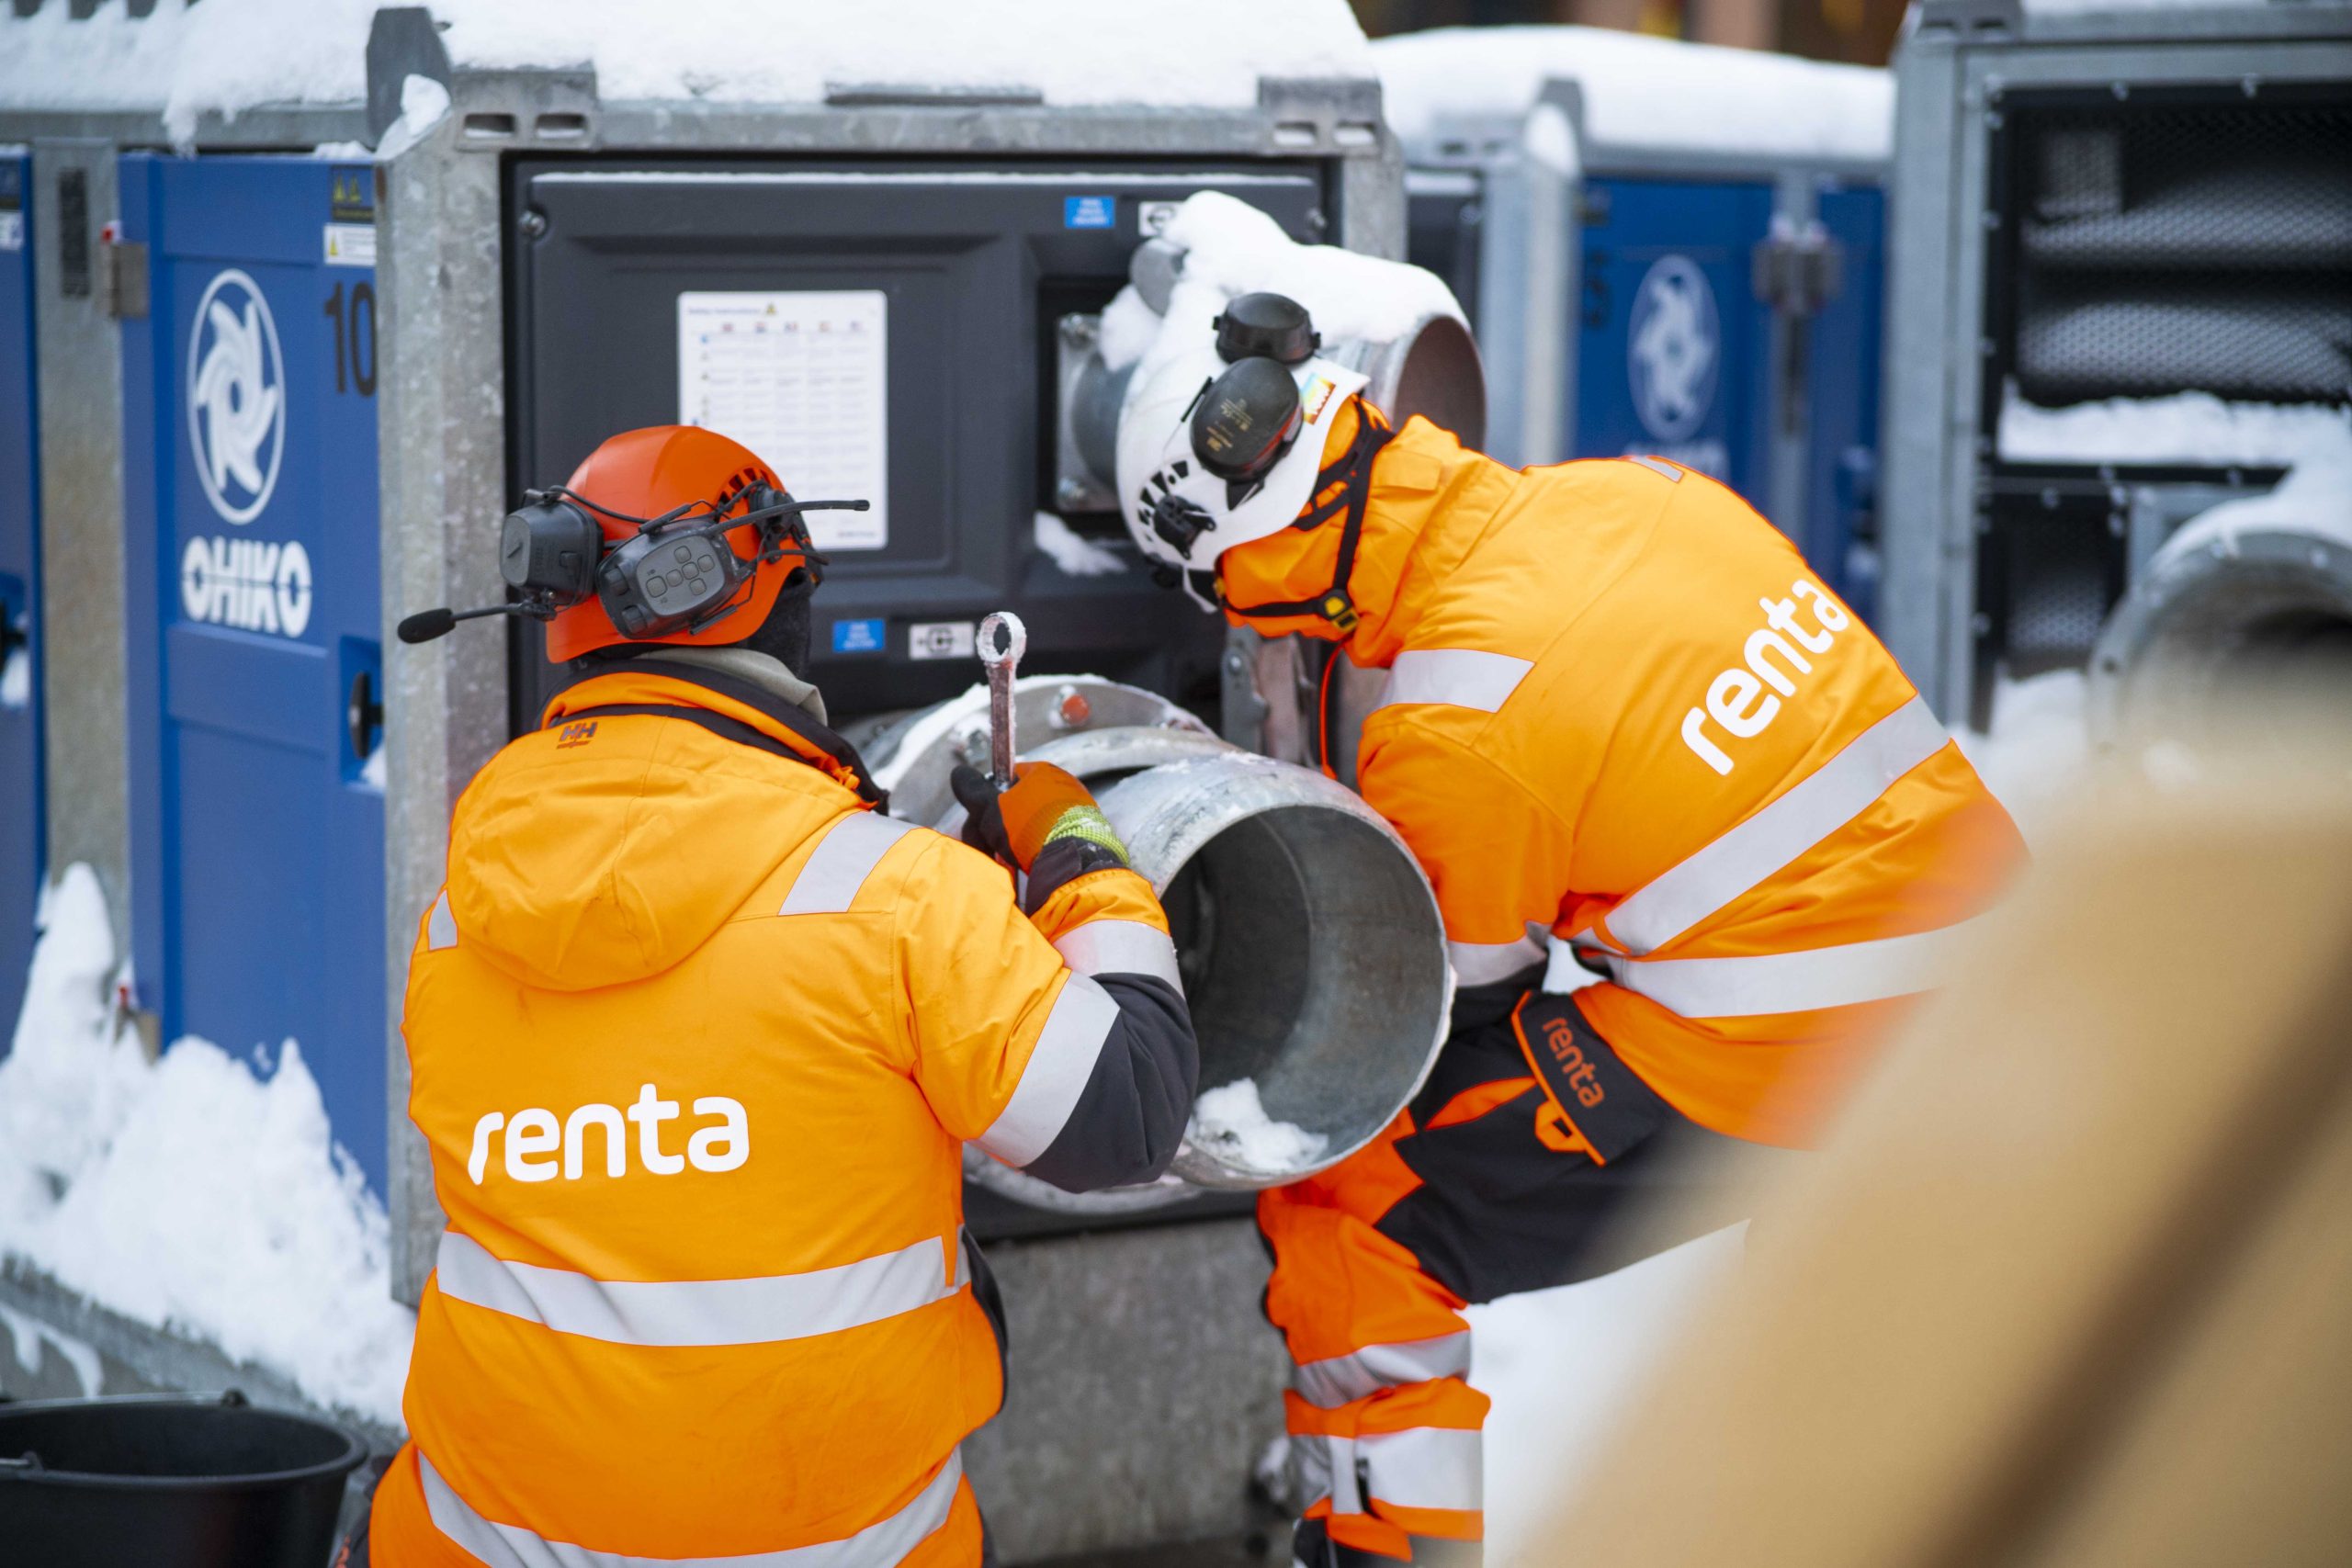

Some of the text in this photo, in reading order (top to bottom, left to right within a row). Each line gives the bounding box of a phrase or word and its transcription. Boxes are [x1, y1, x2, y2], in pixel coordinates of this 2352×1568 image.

[323, 280, 377, 397] 10
[182, 534, 313, 638] OHIKO
[1680, 578, 1849, 776] renta
[1543, 1016, 1605, 1109] renta
[467, 1082, 751, 1186] renta
